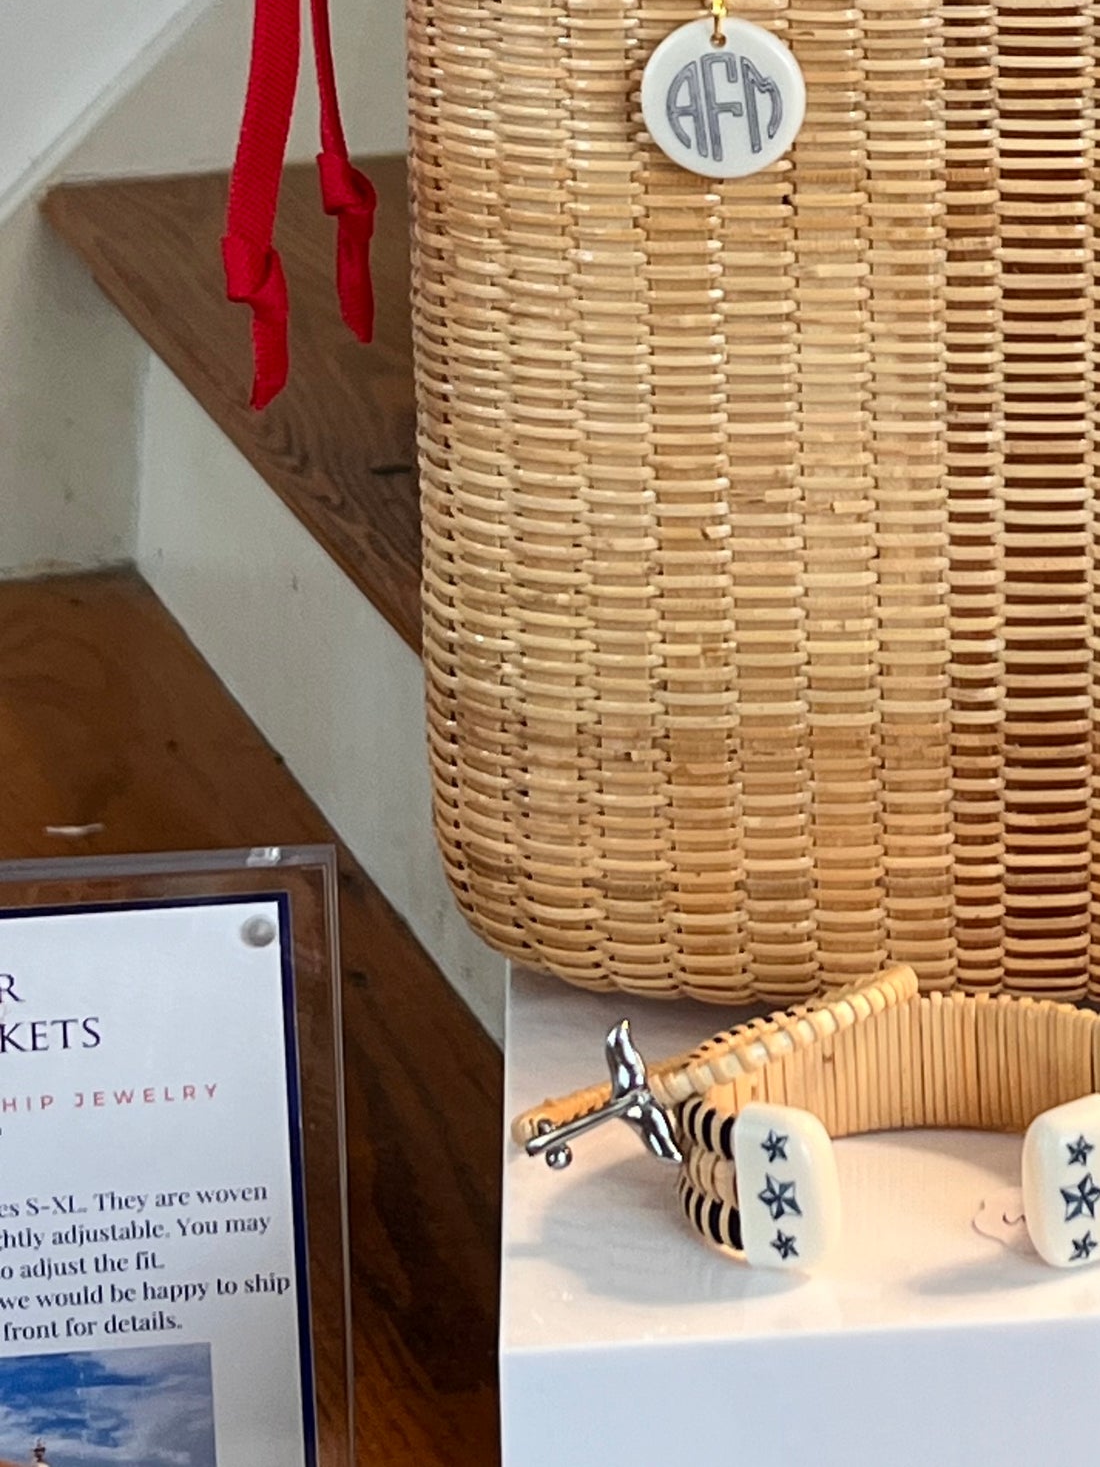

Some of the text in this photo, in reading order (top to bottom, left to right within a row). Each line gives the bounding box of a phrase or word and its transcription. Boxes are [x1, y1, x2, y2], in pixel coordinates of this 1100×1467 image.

[0, 1017, 101, 1053] KETS
[2, 1083, 217, 1113] HIP JEWELRY
[94, 1190, 148, 1213] They
[155, 1189, 190, 1208] are
[196, 1185, 267, 1204] woven
[0, 1214, 271, 1251] htly adjustable. You may
[20, 1256, 87, 1281] adjust
[94, 1253, 129, 1274] the
[135, 1250, 165, 1271] fit.
[36, 1284, 103, 1308] would
[110, 1283, 136, 1303] be
[143, 1281, 209, 1304] happy
[216, 1278, 238, 1296] to
[244, 1272, 291, 1296] ship
[4, 1311, 183, 1342] front for details.
